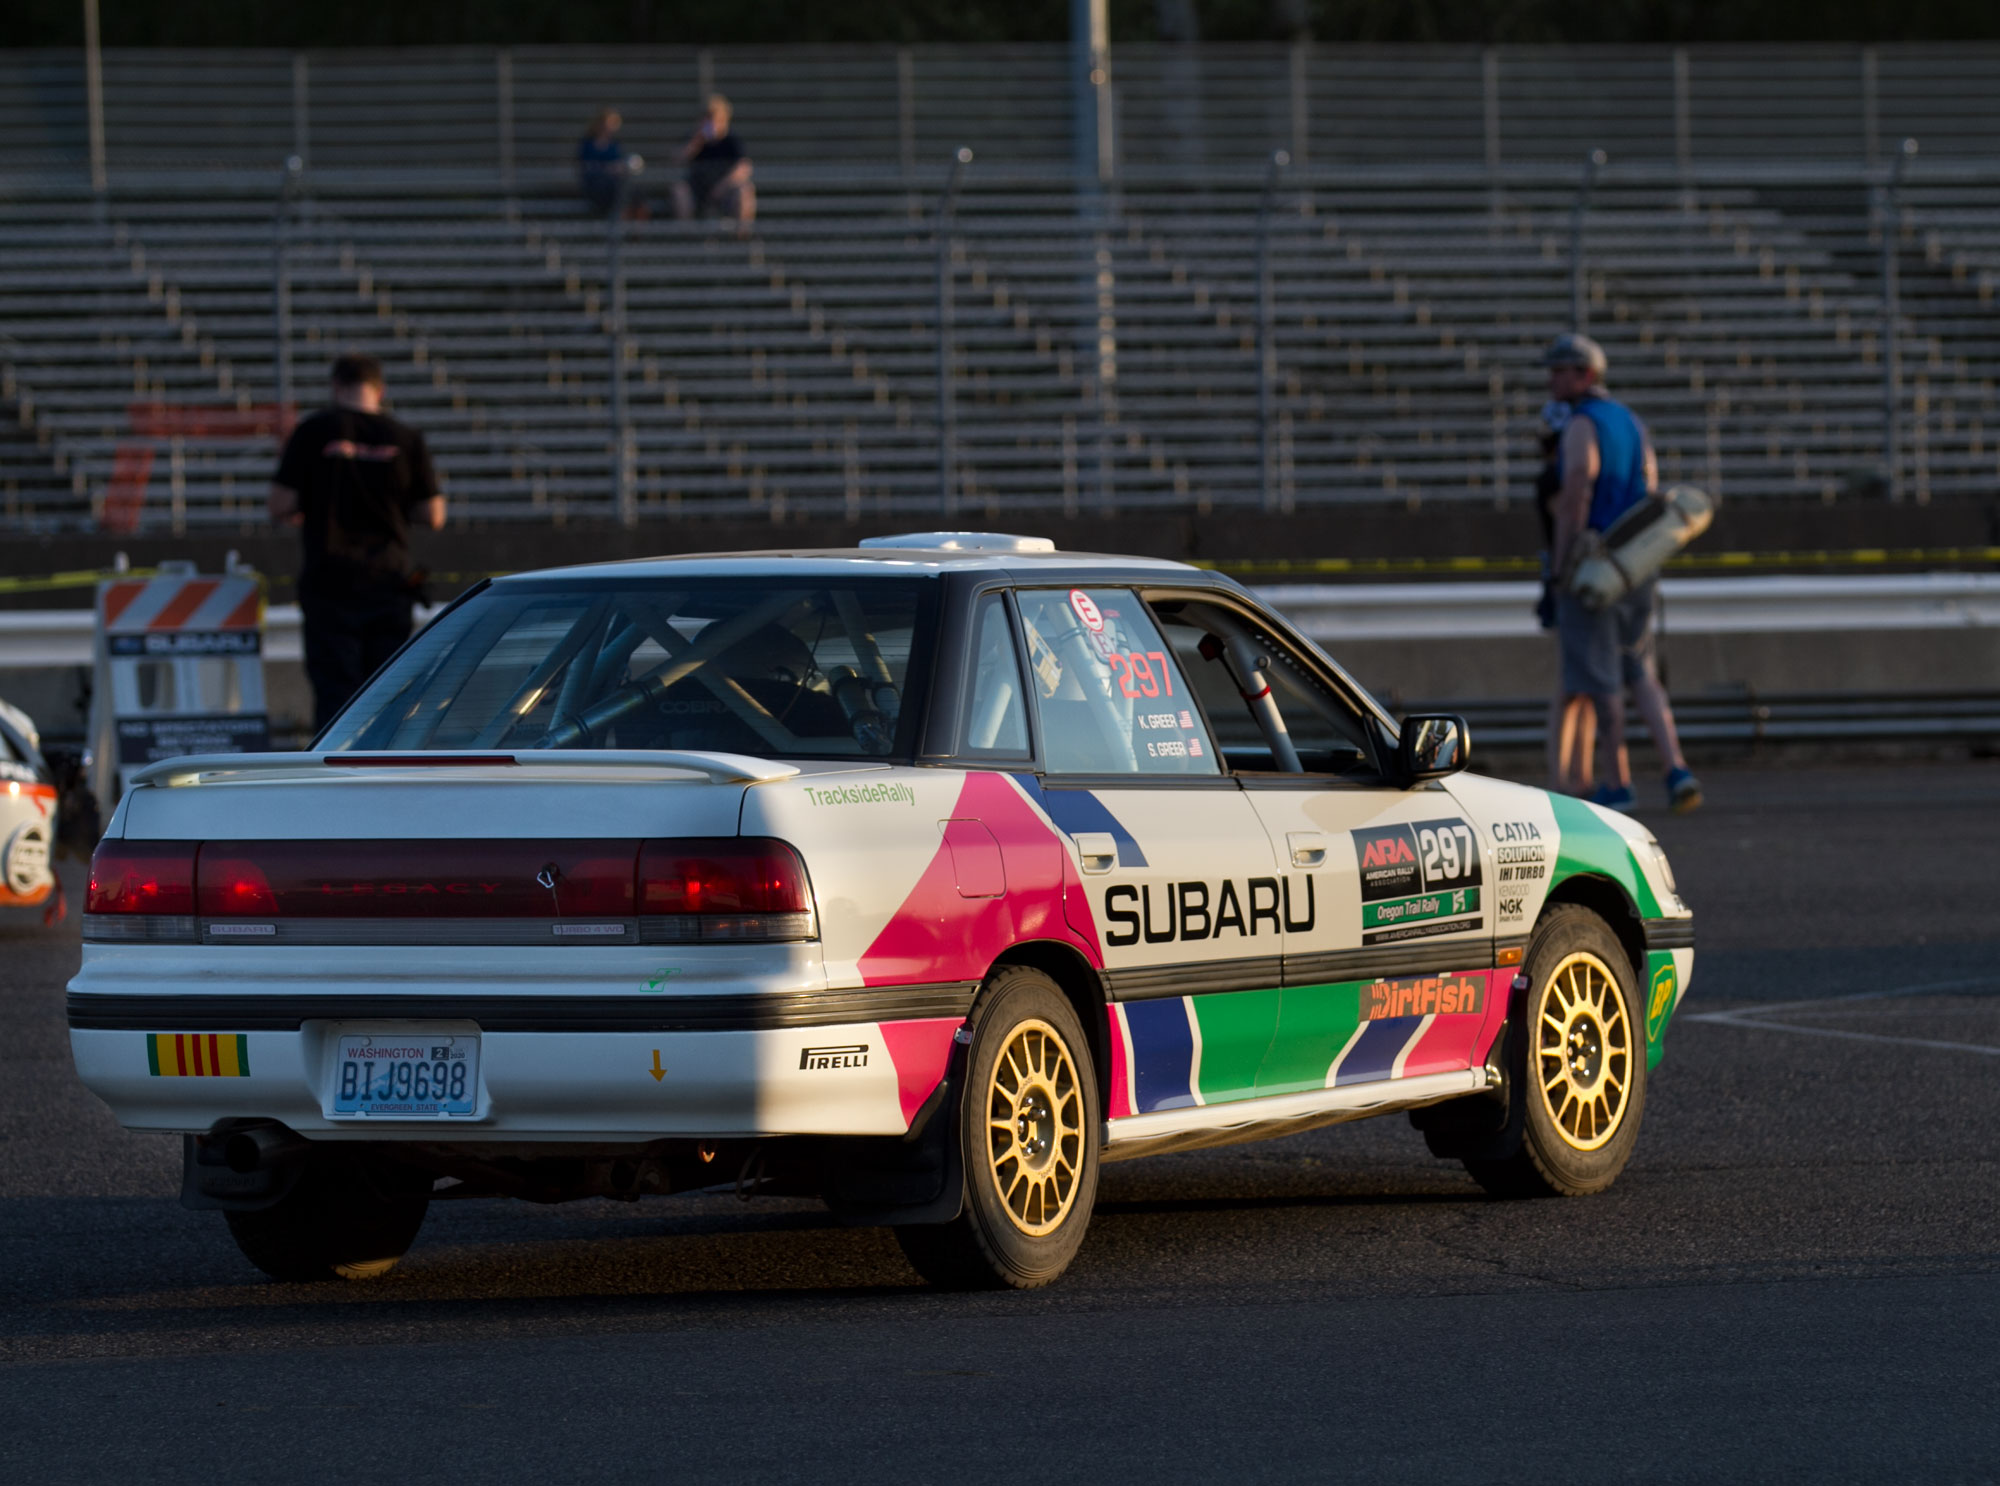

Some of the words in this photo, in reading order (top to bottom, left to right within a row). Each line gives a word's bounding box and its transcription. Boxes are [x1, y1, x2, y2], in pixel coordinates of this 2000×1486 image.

[1076, 598, 1098, 622] E
[146, 633, 256, 650] SUBARU
[1109, 652, 1173, 698] 297
[1149, 714, 1177, 729] GREER
[1157, 741, 1186, 757] GREER
[803, 782, 915, 806] TracksideRally
[1492, 822, 1541, 842] CATIA
[1362, 837, 1416, 868] ARA
[1420, 825, 1473, 882] 297
[1498, 846, 1545, 864] SOLUTION
[1366, 868, 1396, 880] AMERICAN
[1397, 866, 1415, 876] RALLY
[1499, 867, 1514, 881] IHI
[1515, 865, 1545, 880] TURBO
[321, 883, 502, 895] LEGACY
[1105, 874, 1315, 946] SUBARU
[1377, 905, 1404, 921] Oregon
[1405, 899, 1420, 915] Trail
[1422, 897, 1440, 914] Rally
[1499, 899, 1523, 915] NGK
[212, 925, 274, 933] SUBARU
[1369, 977, 1475, 1020] DirtFish
[1650, 978, 1672, 1019] BP
[347, 1048, 424, 1059] WASHINGTON
[799, 1044, 869, 1070] PIRELLI
[341, 1061, 467, 1101] BIJ9698
[371, 1103, 413, 1111] EVERGREEN
[416, 1103, 438, 1111] STATE
